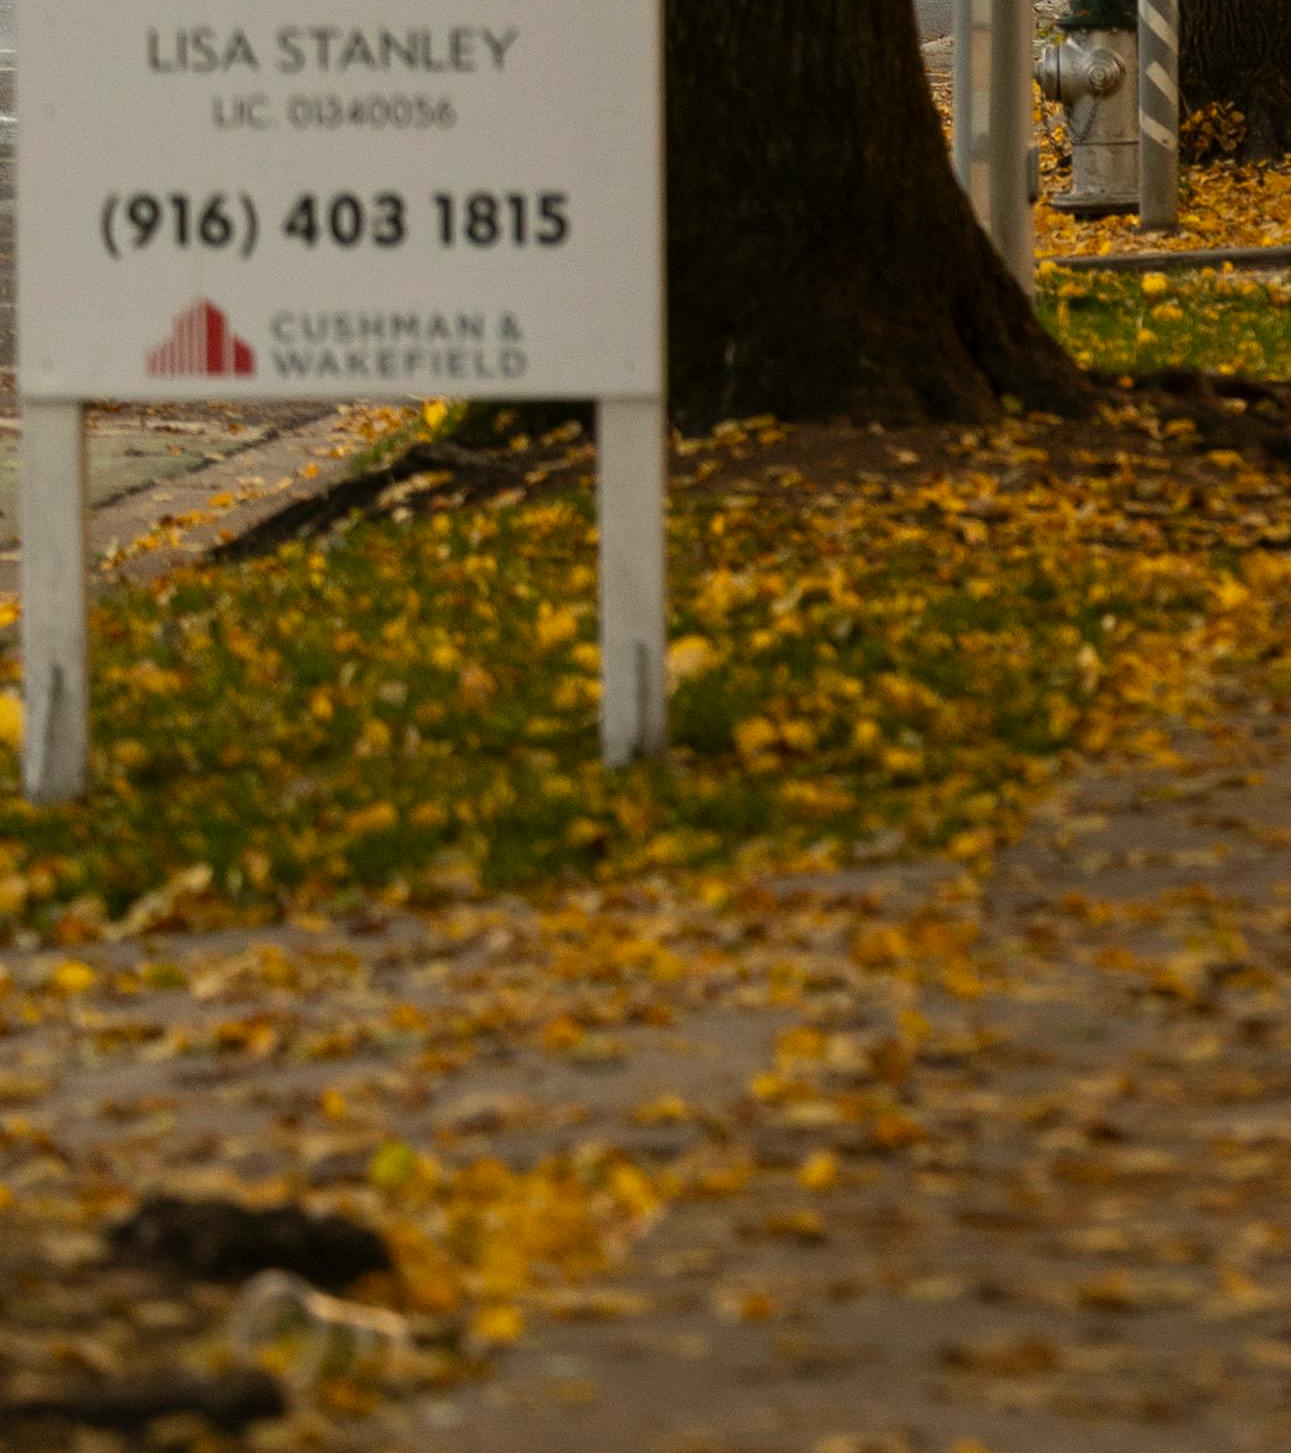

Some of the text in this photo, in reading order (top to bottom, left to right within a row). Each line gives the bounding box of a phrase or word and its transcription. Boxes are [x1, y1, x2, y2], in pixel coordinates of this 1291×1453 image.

[146, 26, 518, 73] LISA STANLEY
[101, 191, 571, 259] (916) 403 1815
[269, 310, 522, 343] CUSHMAN &
[271, 346, 528, 379] WAKEFIELD
